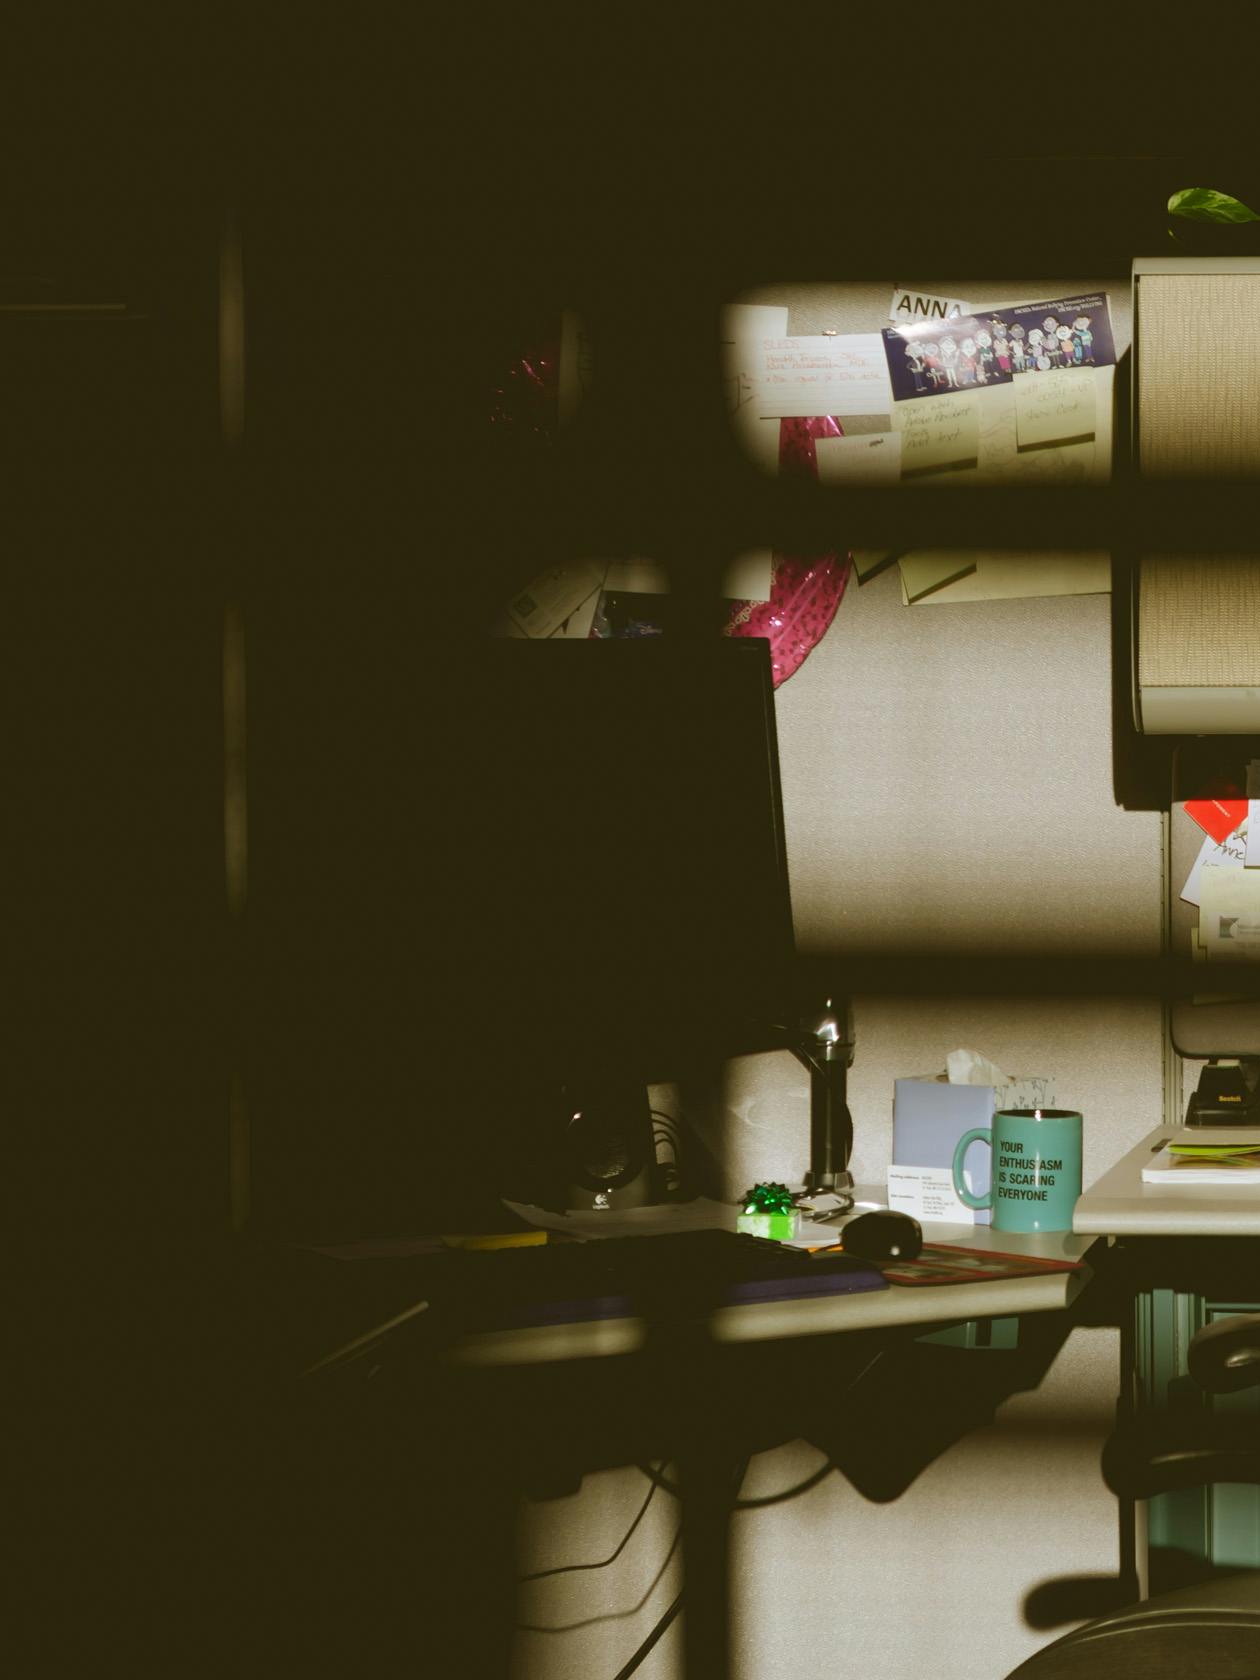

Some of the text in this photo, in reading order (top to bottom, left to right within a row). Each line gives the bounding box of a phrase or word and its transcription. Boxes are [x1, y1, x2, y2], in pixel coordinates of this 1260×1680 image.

[897, 295, 962, 319] ANNA
[1000, 1140, 1023, 1153] YOUR
[999, 1156, 1063, 1171] ENTHUSASM
[999, 1172, 1007, 1183] IS
[998, 1187, 1048, 1202] EVERYONE
